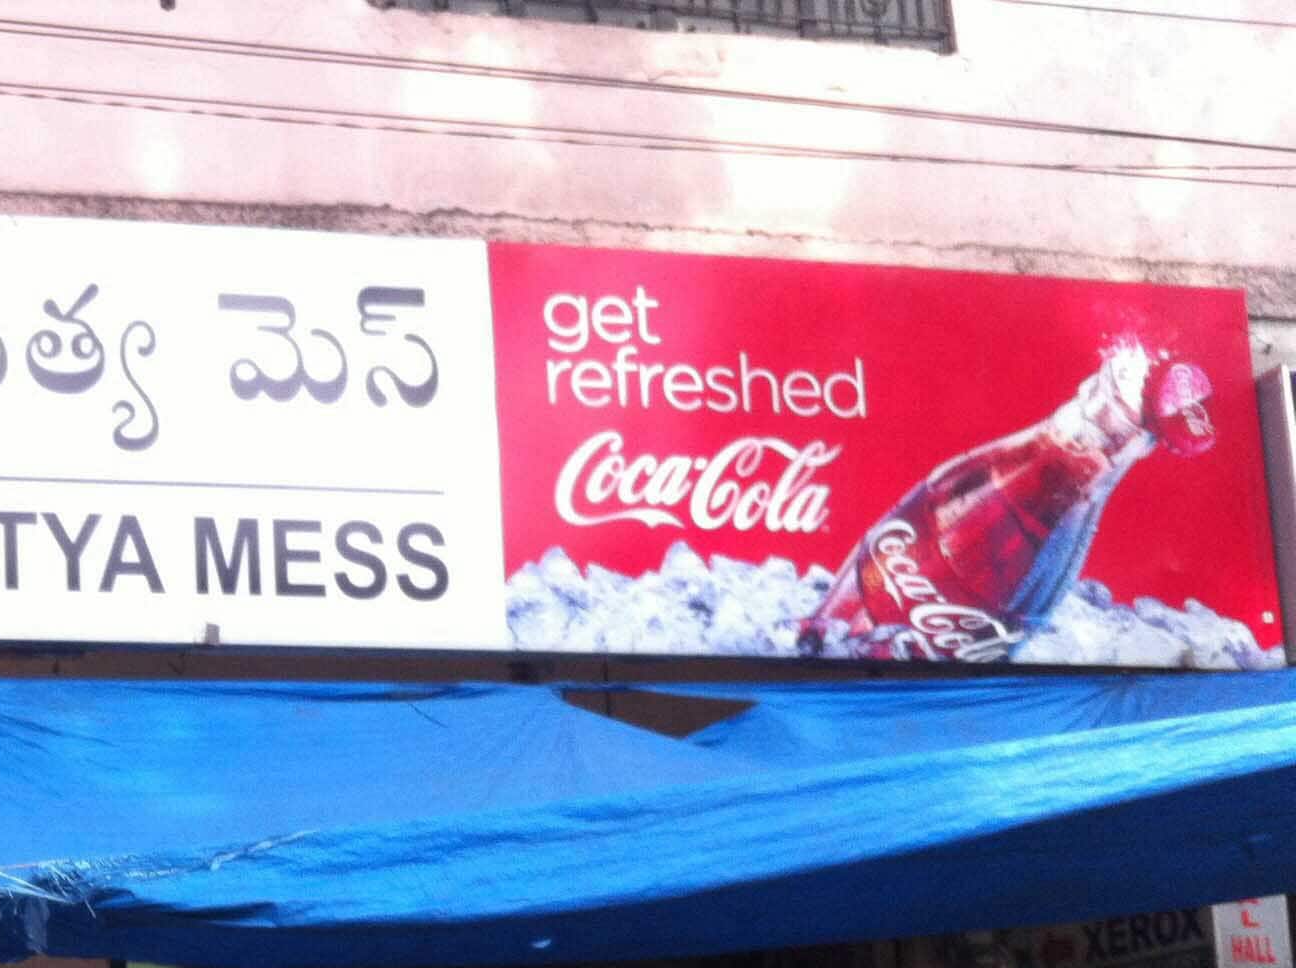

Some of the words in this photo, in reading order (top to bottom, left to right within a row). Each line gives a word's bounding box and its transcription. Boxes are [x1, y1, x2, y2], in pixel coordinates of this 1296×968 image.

[218, 286, 439, 408] మెస్
[543, 285, 662, 352] get
[545, 346, 867, 419] refreshed
[555, 429, 842, 533] Coca-Cola
[193, 516, 450, 601] MESS
[1082, 907, 1203, 958] XEROX
[1231, 935, 1278, 964] HALL
